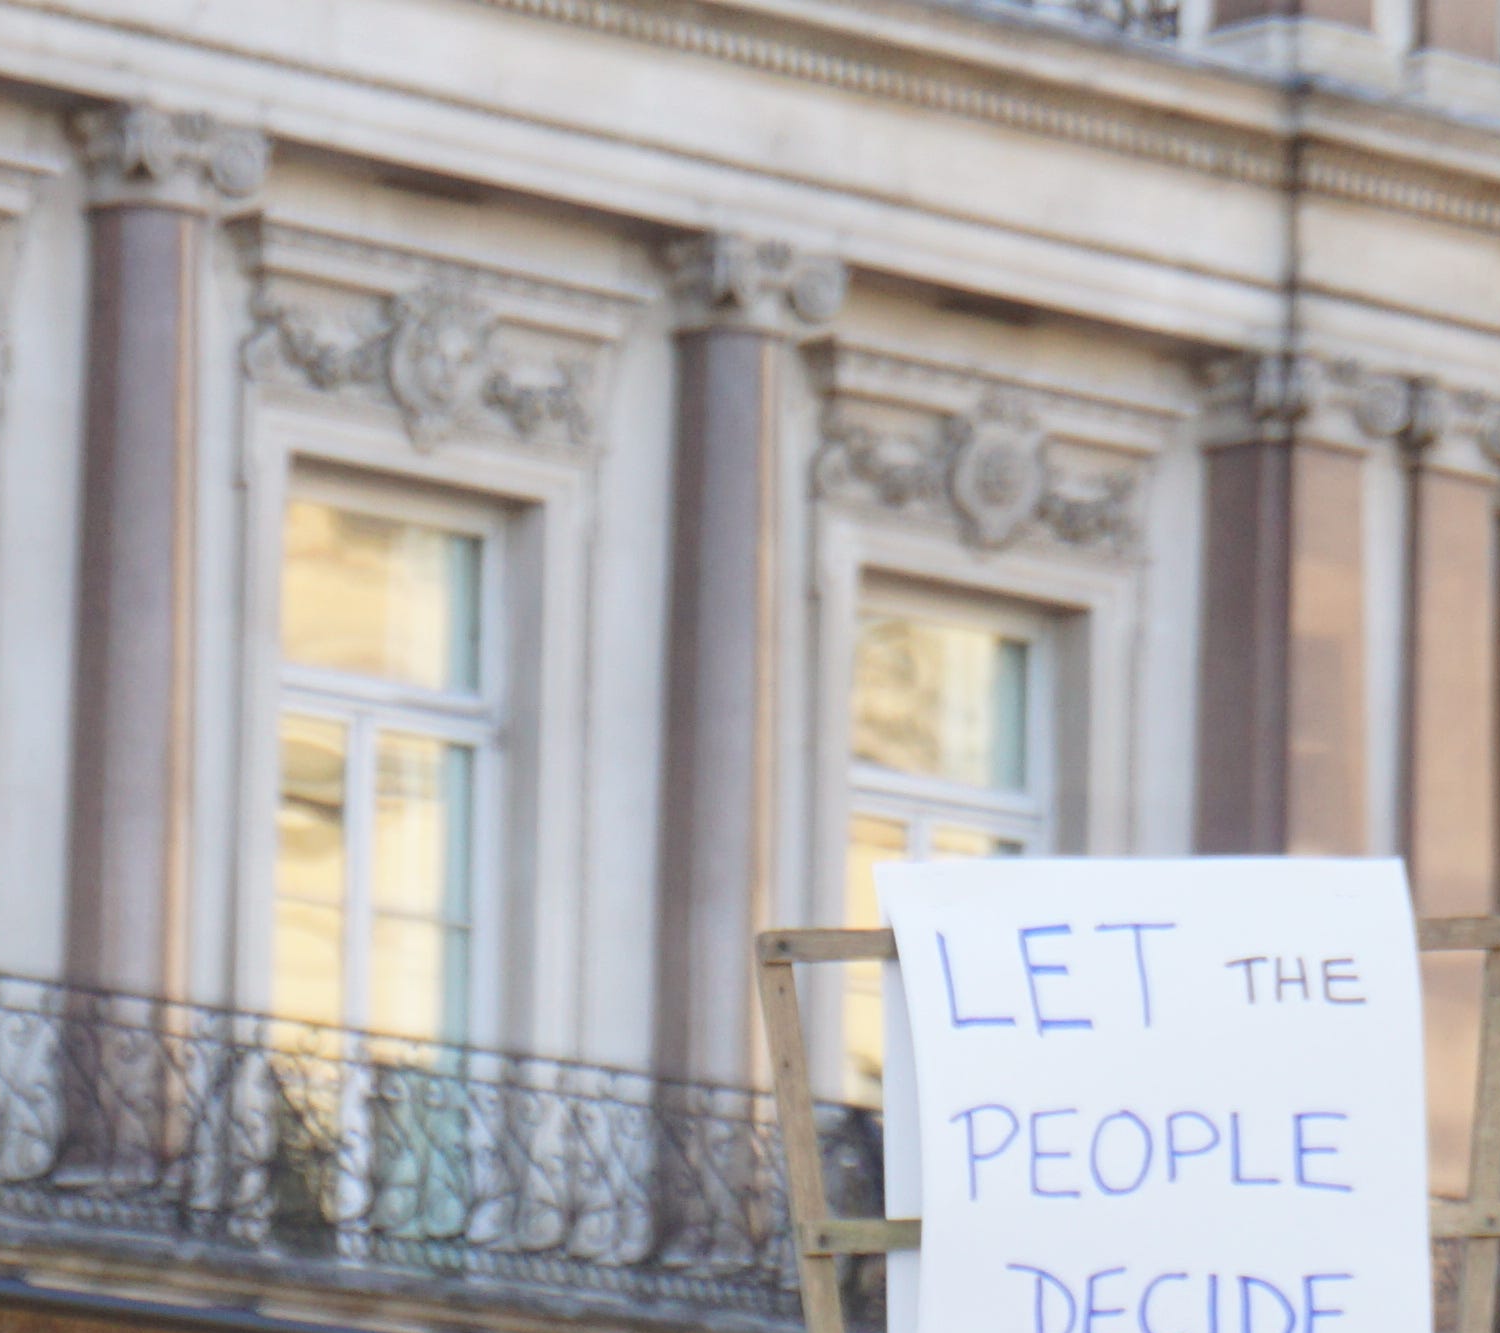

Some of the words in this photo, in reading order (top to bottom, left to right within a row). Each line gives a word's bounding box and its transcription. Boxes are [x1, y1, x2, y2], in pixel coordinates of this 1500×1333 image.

[936, 921, 1178, 1036] LET
[1225, 955, 1367, 1006] THE
[950, 1103, 1355, 1200] PEOPLE
